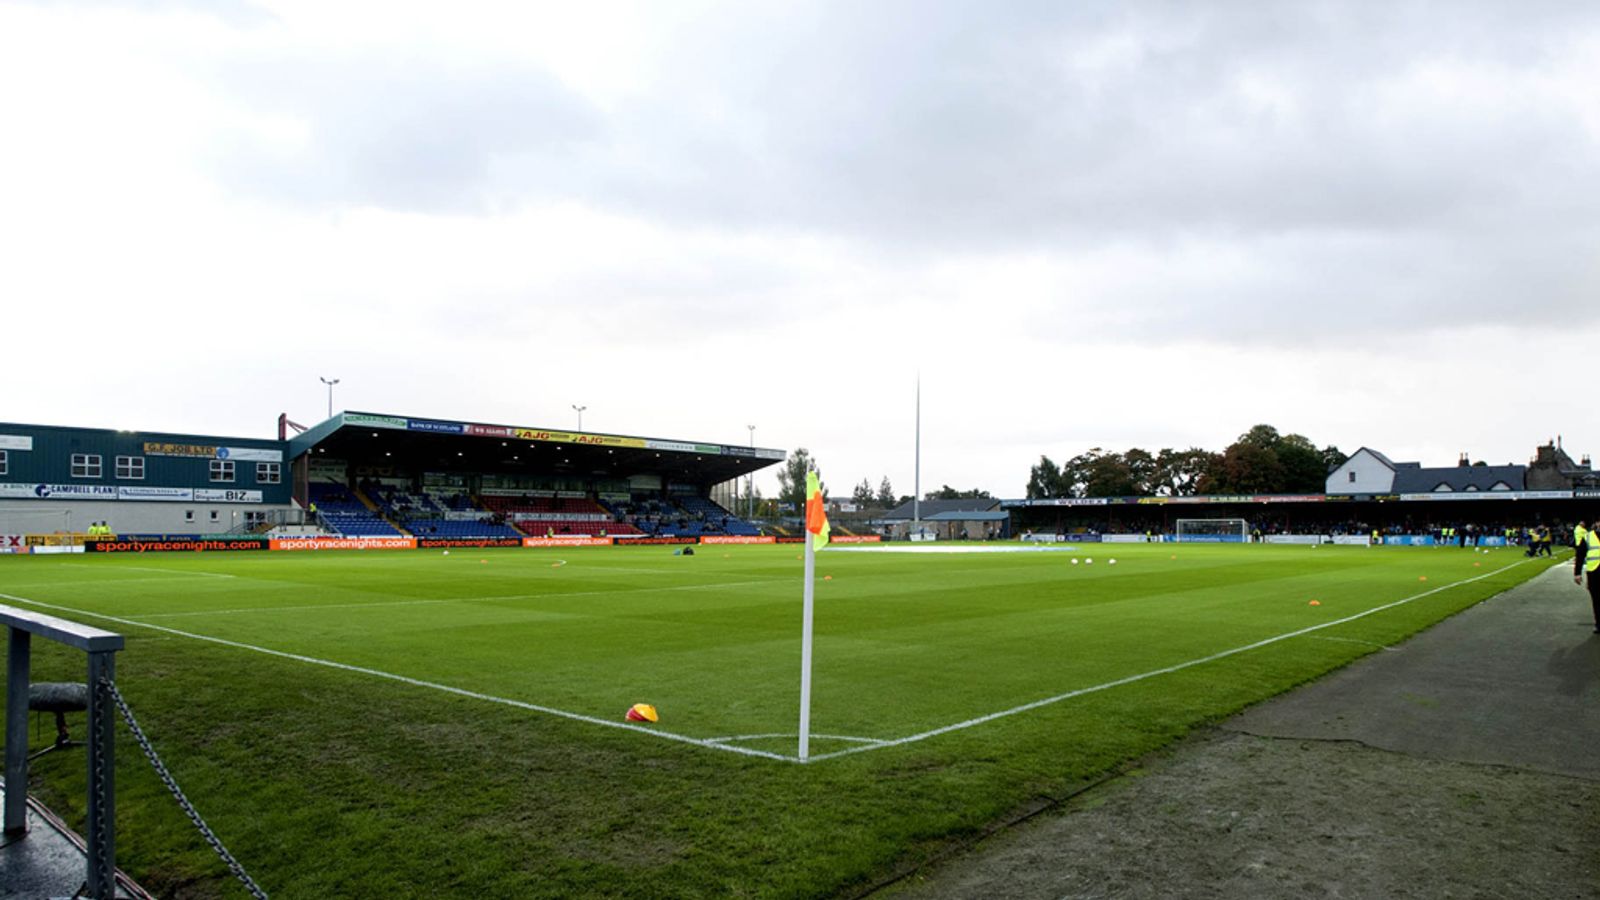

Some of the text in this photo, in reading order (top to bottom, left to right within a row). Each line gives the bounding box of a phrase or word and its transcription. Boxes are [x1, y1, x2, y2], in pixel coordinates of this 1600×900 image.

[523, 431, 550, 439] AJG
[578, 435, 603, 443] AJG
[194, 446, 214, 455] LTD
[51, 484, 91, 493] CAMPBELL
[225, 491, 247, 501] BIZ
[96, 539, 261, 552] sportyracenights.com
[279, 539, 411, 550] sportyracenights.com
[421, 538, 519, 548] sportyracenights.com
[527, 537, 609, 546] sportyracenights.com
